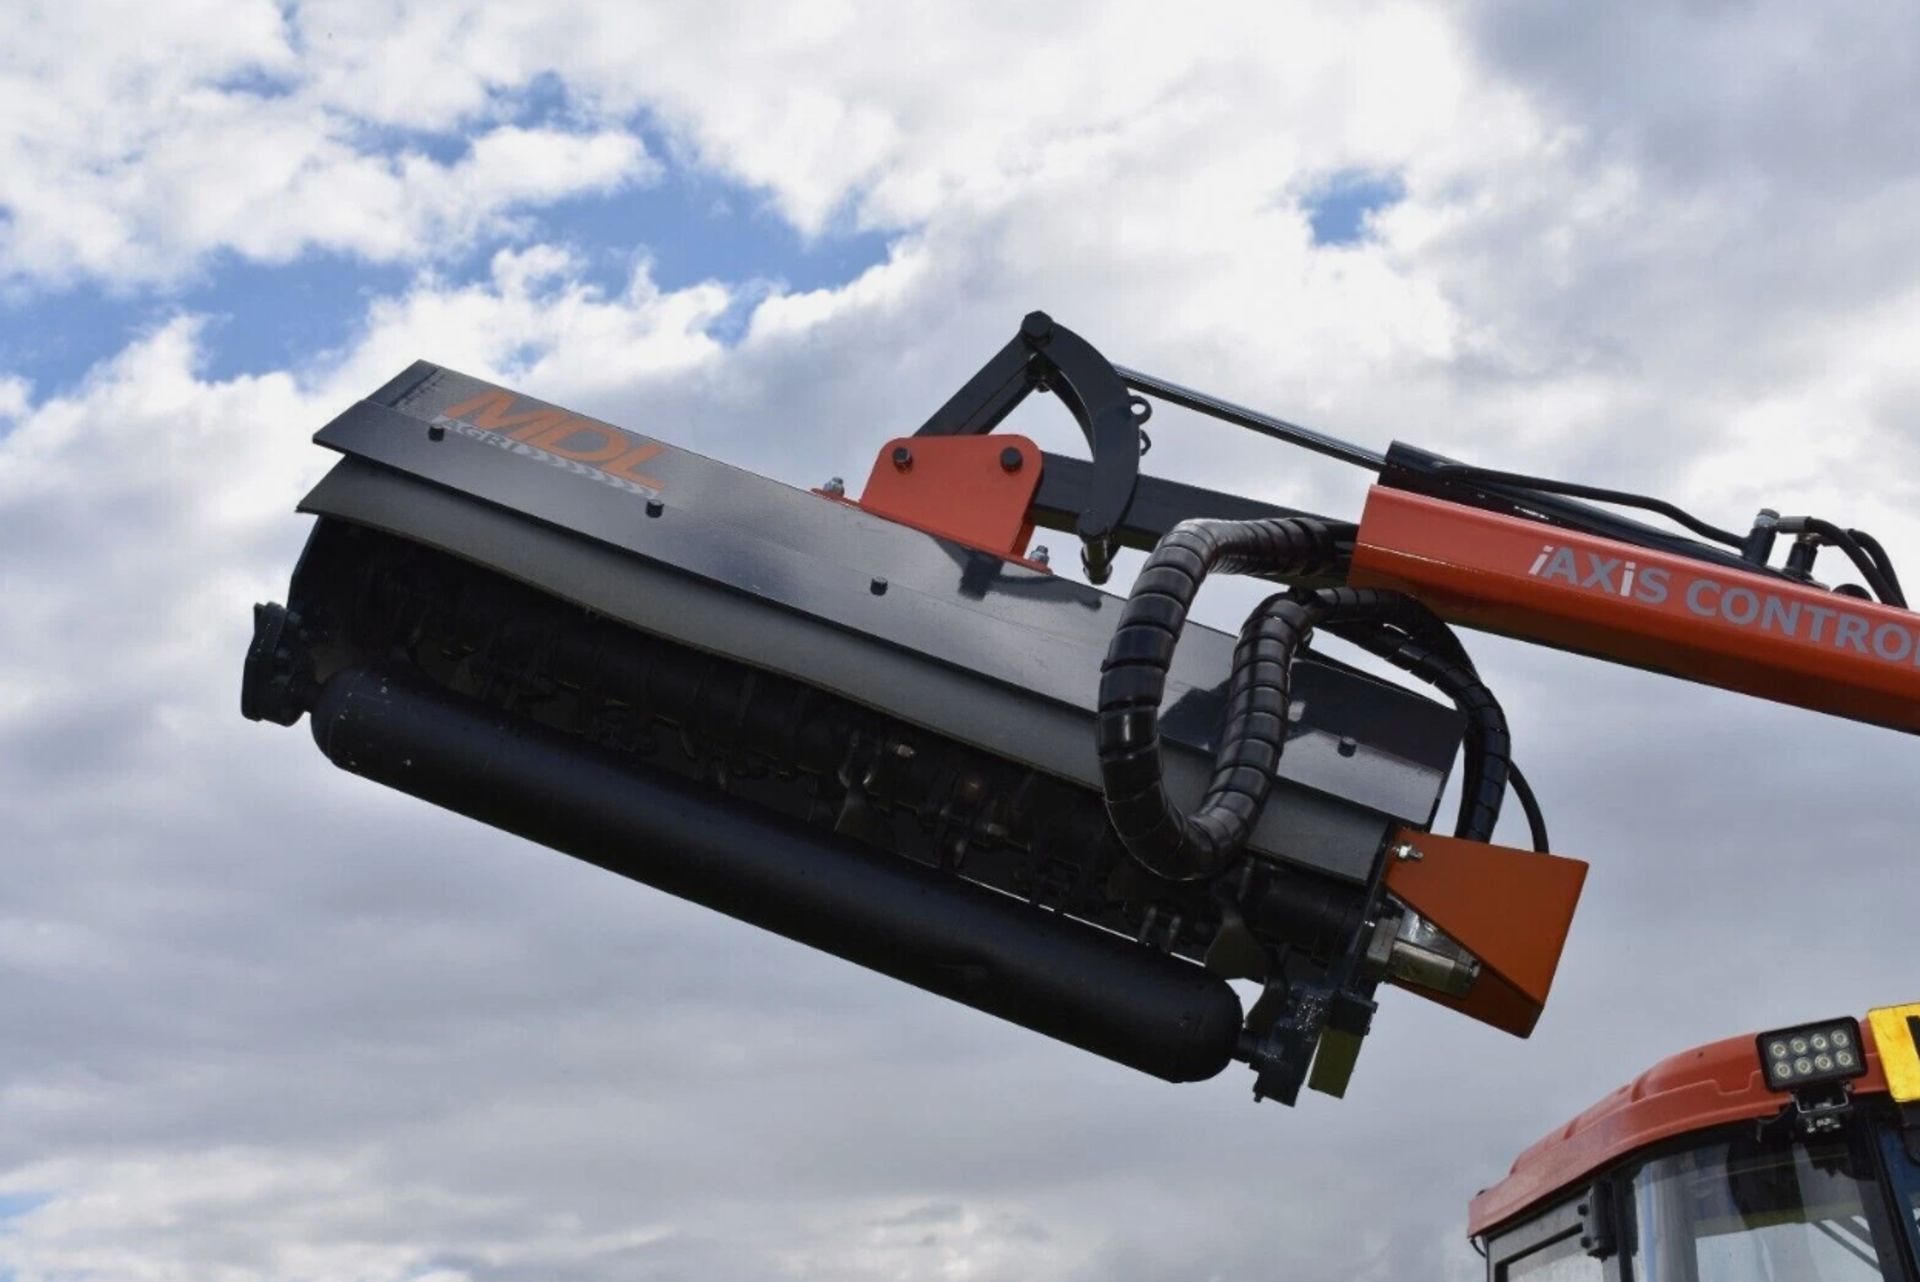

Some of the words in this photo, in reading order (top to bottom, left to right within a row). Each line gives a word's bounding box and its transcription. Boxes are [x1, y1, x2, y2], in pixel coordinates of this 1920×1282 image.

[444, 389, 665, 491] MDL
[1528, 545, 1671, 605] iAXiS
[1686, 580, 1920, 668] CONTRO
